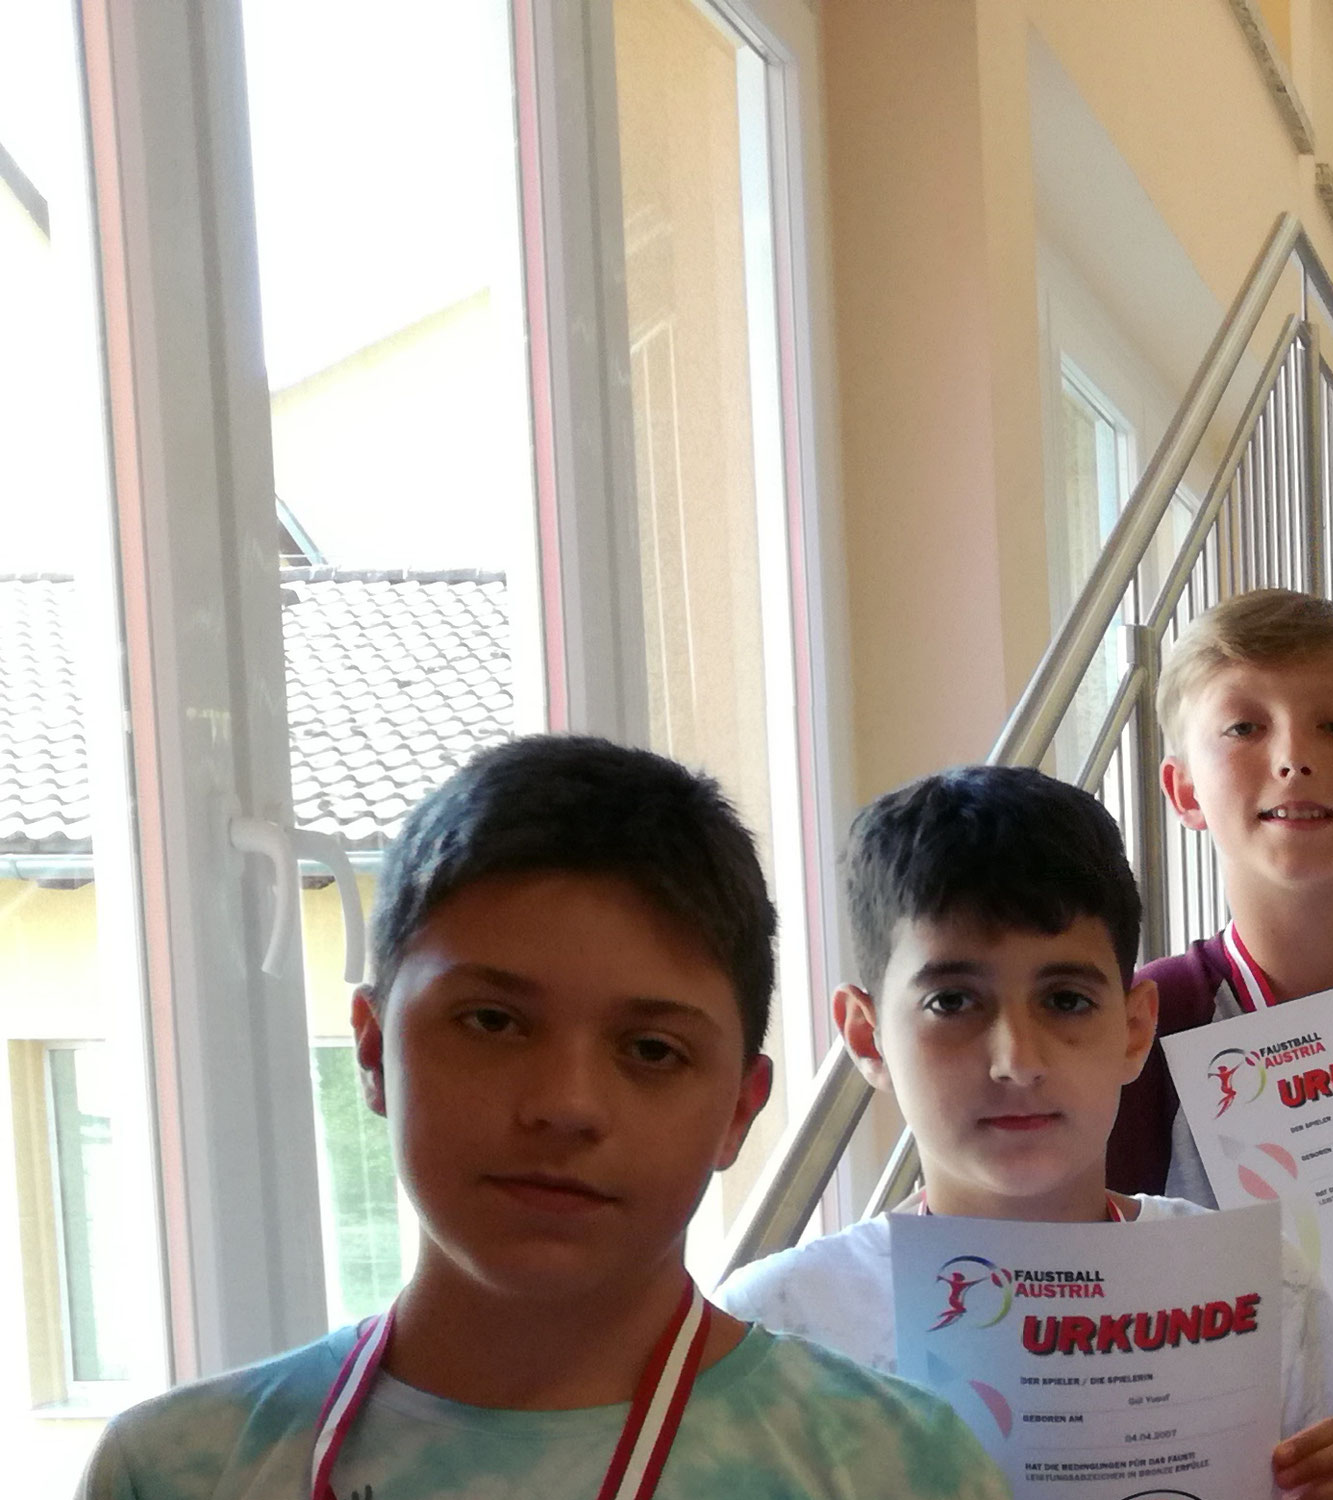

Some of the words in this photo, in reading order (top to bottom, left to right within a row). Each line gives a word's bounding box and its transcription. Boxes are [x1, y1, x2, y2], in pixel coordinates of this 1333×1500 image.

[1259, 1032, 1321, 1057] FAUSTBALL
[1264, 1042, 1326, 1069] AUSTRIA
[1014, 1268, 1105, 1283] FAUSTBALL
[1014, 1282, 1106, 1299] AUSTRIA
[1022, 1292, 1261, 1356] URKUNDE
